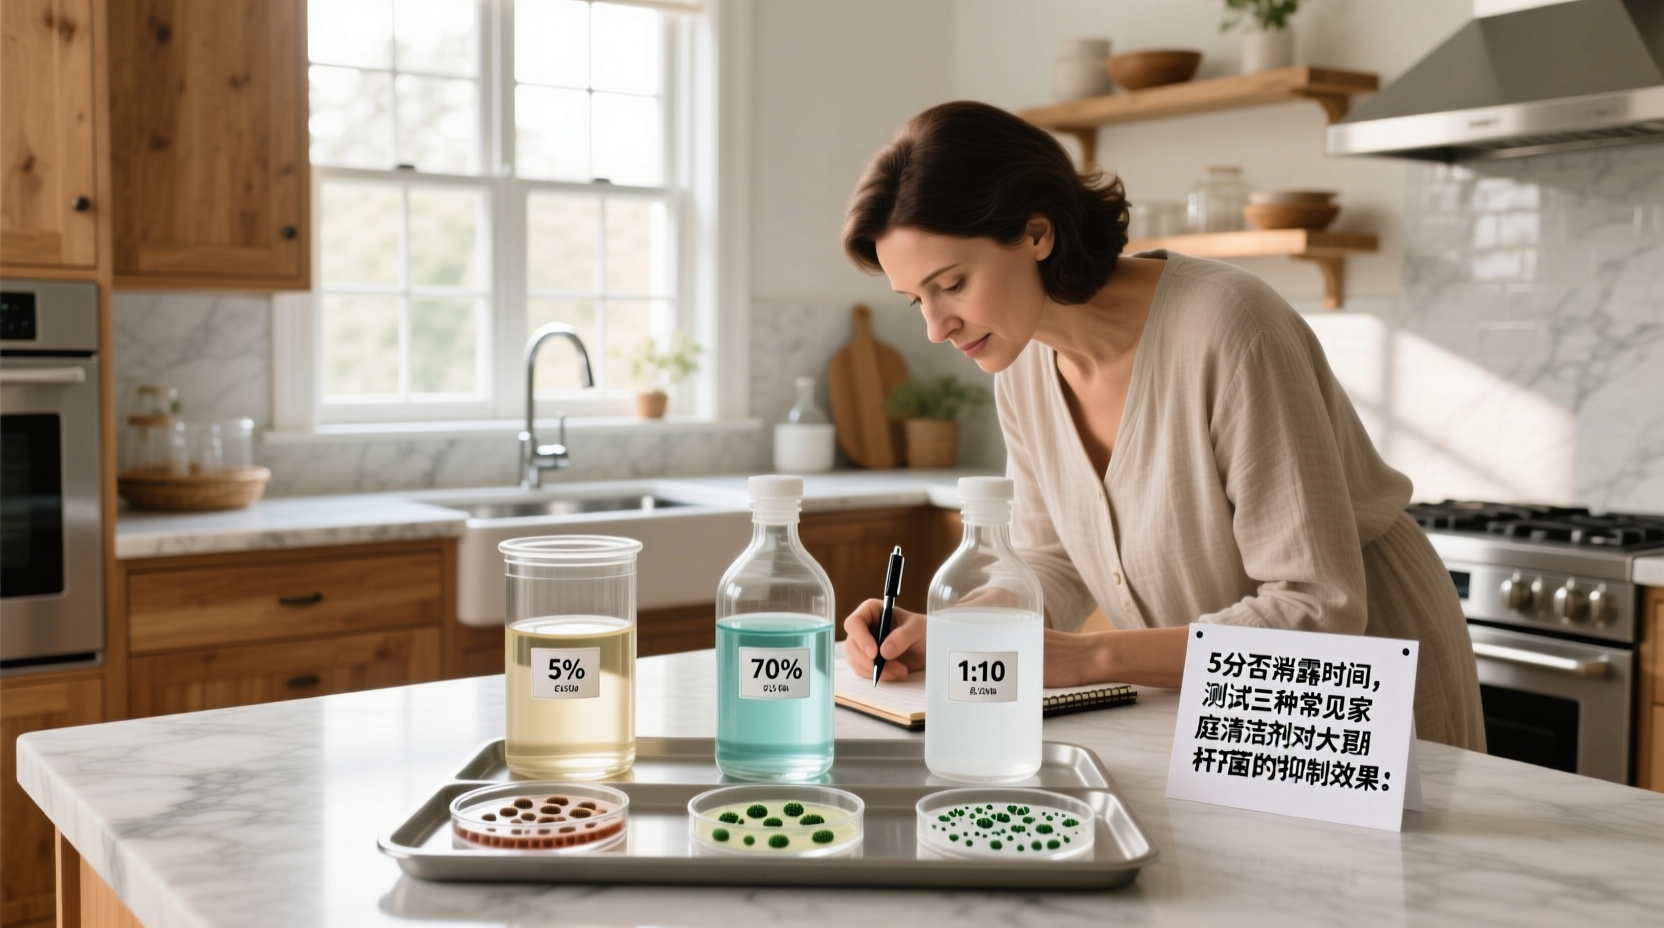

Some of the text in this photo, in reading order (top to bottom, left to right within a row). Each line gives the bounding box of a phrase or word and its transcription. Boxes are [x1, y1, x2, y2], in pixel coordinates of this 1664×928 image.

[548, 658, 586, 680] 5%
[751, 658, 803, 680] 70%
[958, 659, 1006, 682] 1:10
[1202, 682, 1373, 723] 测试三种常见家
